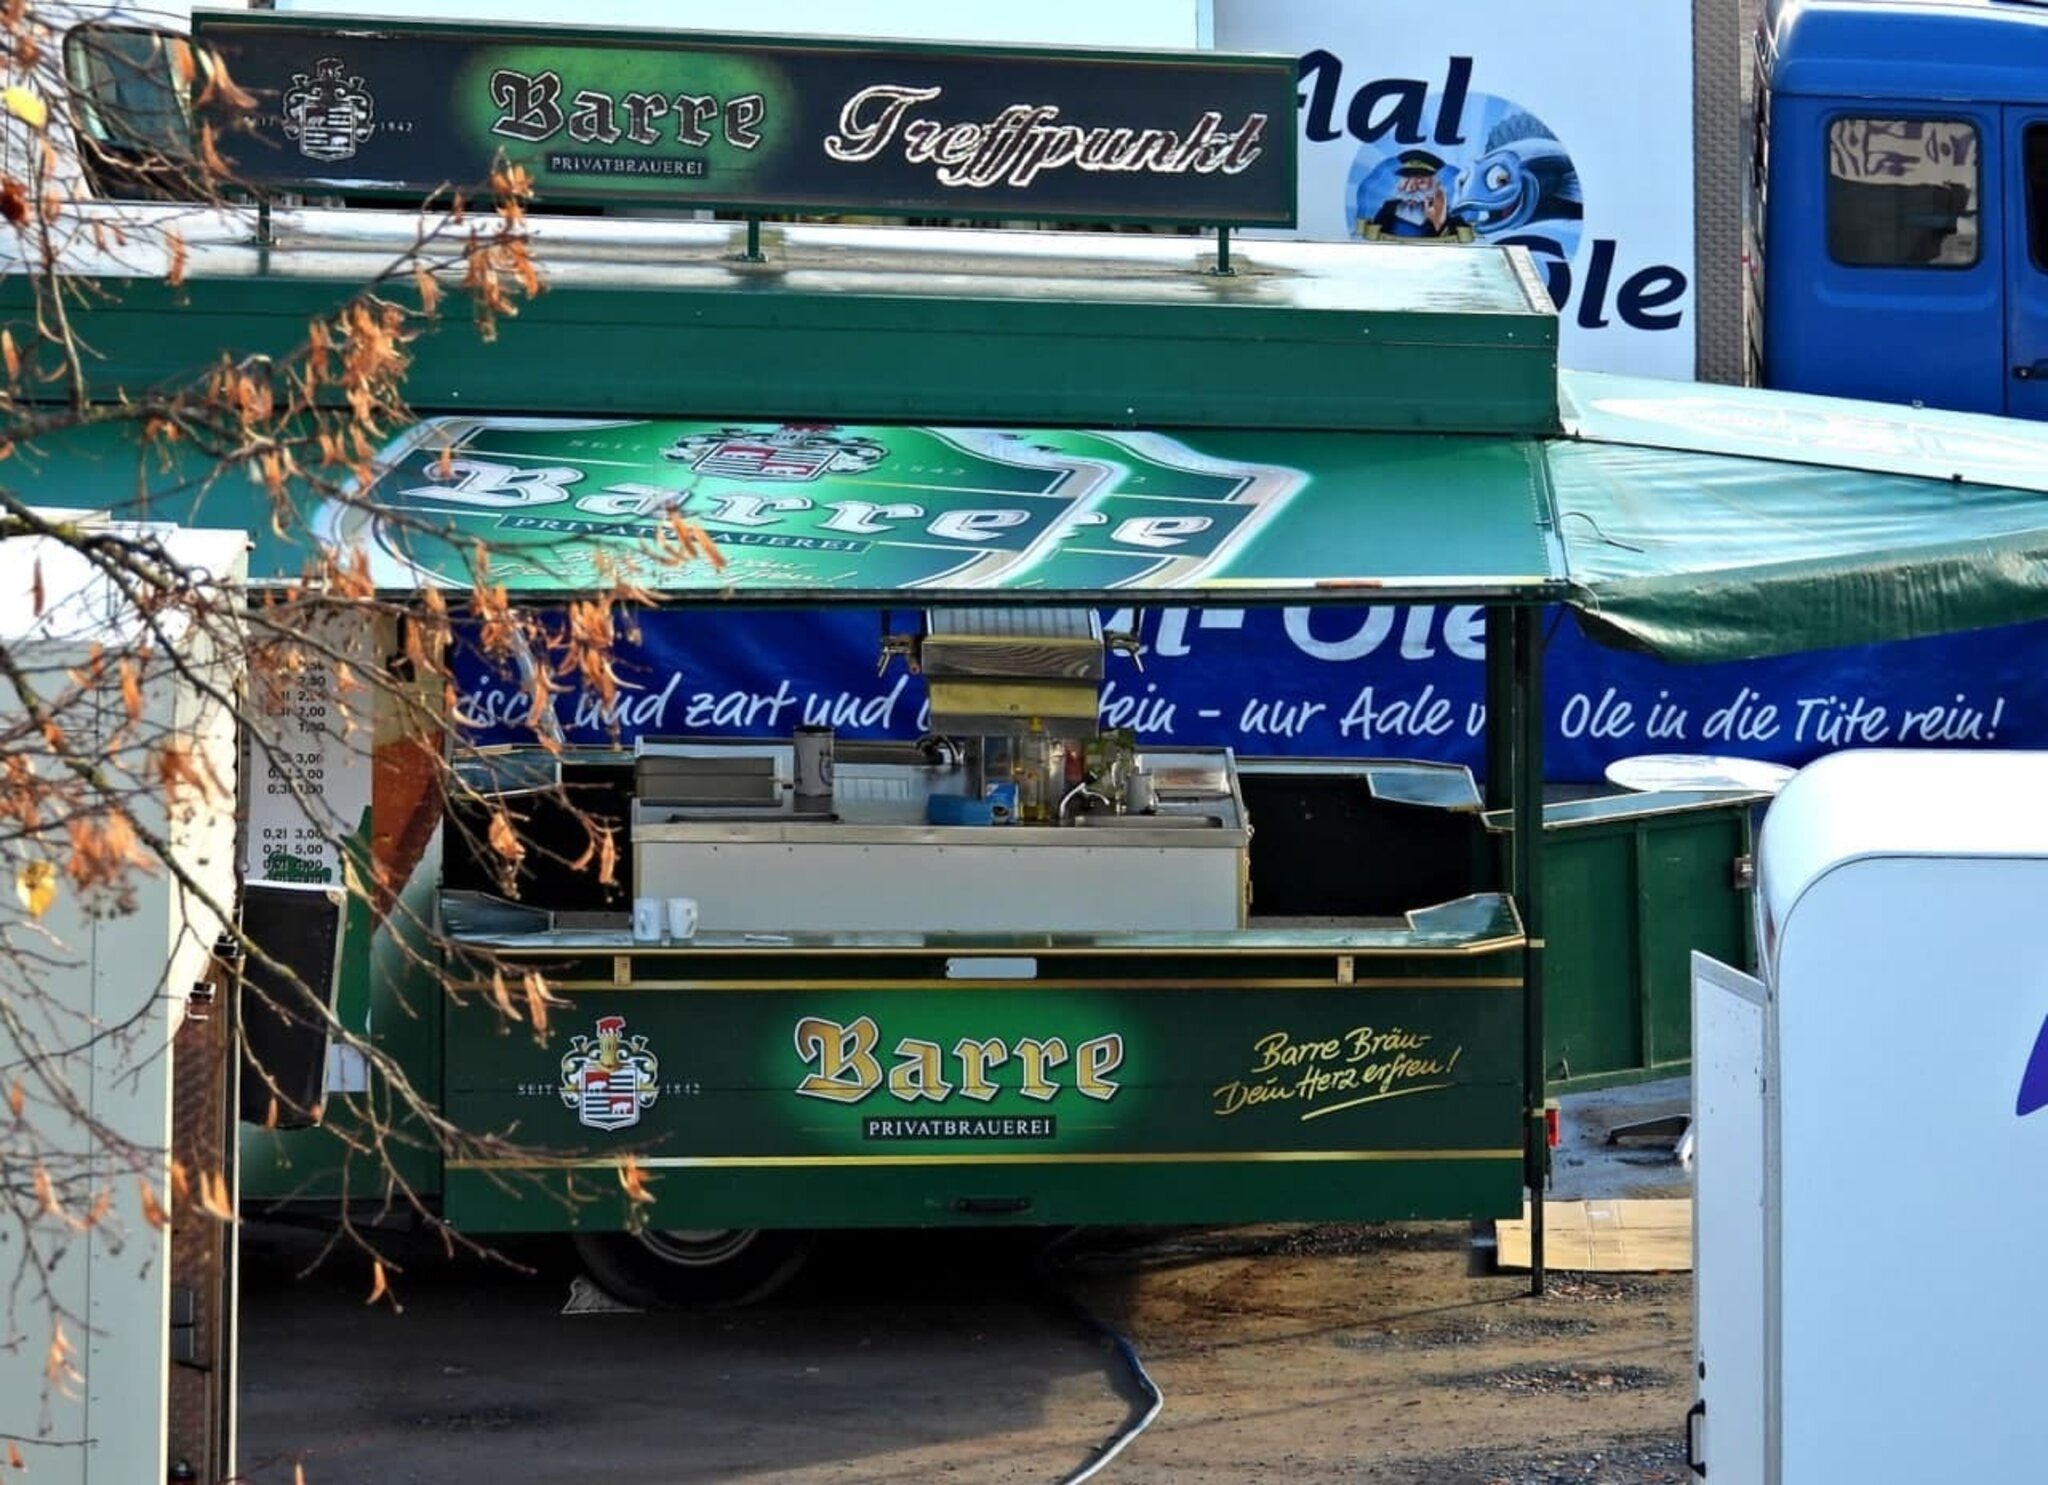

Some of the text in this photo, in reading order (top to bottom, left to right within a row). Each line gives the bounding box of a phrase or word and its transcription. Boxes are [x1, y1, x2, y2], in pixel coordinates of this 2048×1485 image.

[490, 69, 1267, 187] Barre Treffpunkt
[551, 156, 703, 175] PRIVATBRAUEREI
[397, 459, 1031, 541] Barre
[685, 679, 799, 728] zart
[802, 673, 910, 730] und
[1239, 697, 1326, 738] nur
[1339, 684, 1456, 740] Aale
[1560, 687, 2005, 746] Ole in die Tüte rein!
[295, 844, 323, 856] 5,00
[795, 1016, 1124, 1103] Barre
[1252, 1026, 1432, 1073] Barre Bräu-
[517, 1083, 554, 1095] SEIT
[1213, 1077, 1296, 1115] Dein
[1297, 1065, 1360, 1100] Herz
[869, 1119, 1051, 1137] PRIVATBRAUEREI
